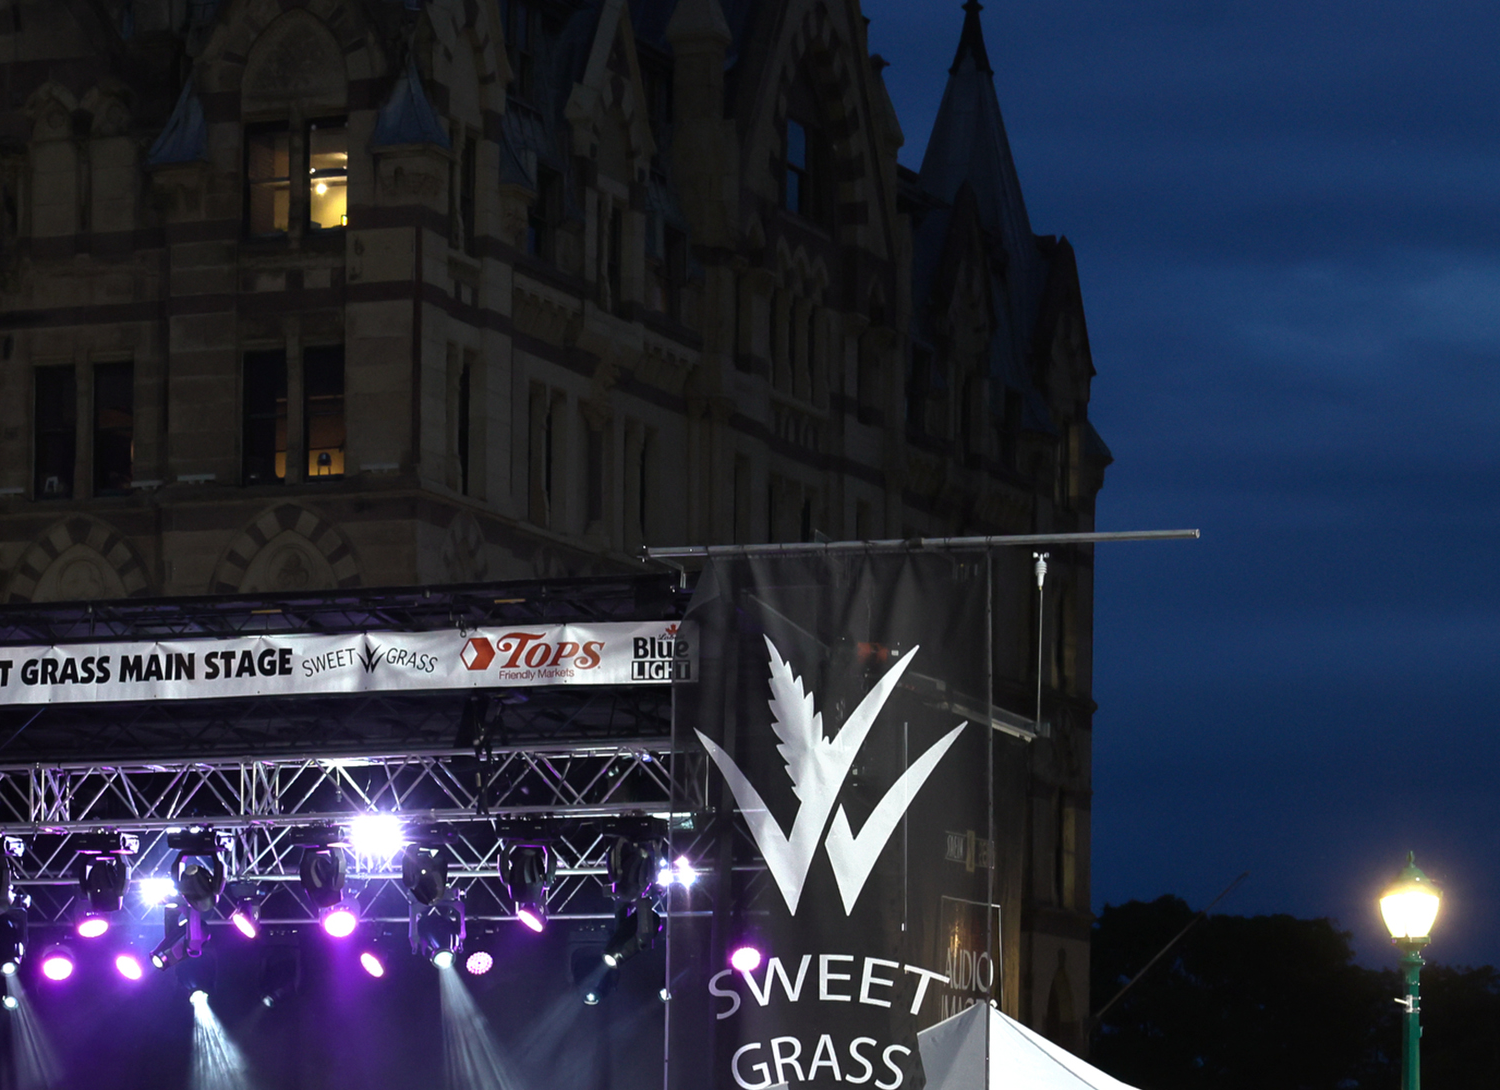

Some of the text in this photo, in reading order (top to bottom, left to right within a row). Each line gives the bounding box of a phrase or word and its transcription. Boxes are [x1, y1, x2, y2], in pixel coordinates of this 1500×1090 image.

[302, 647, 438, 677] SWEET GRASS
[633, 637, 689, 659] Blue
[21, 656, 111, 685] GRASS
[119, 653, 195, 682] MAIN
[204, 648, 293, 679] STAGE
[499, 667, 575, 680] Friendly Markets
[708, 953, 950, 1020] SWEET
[731, 1034, 912, 1090] GRASS
